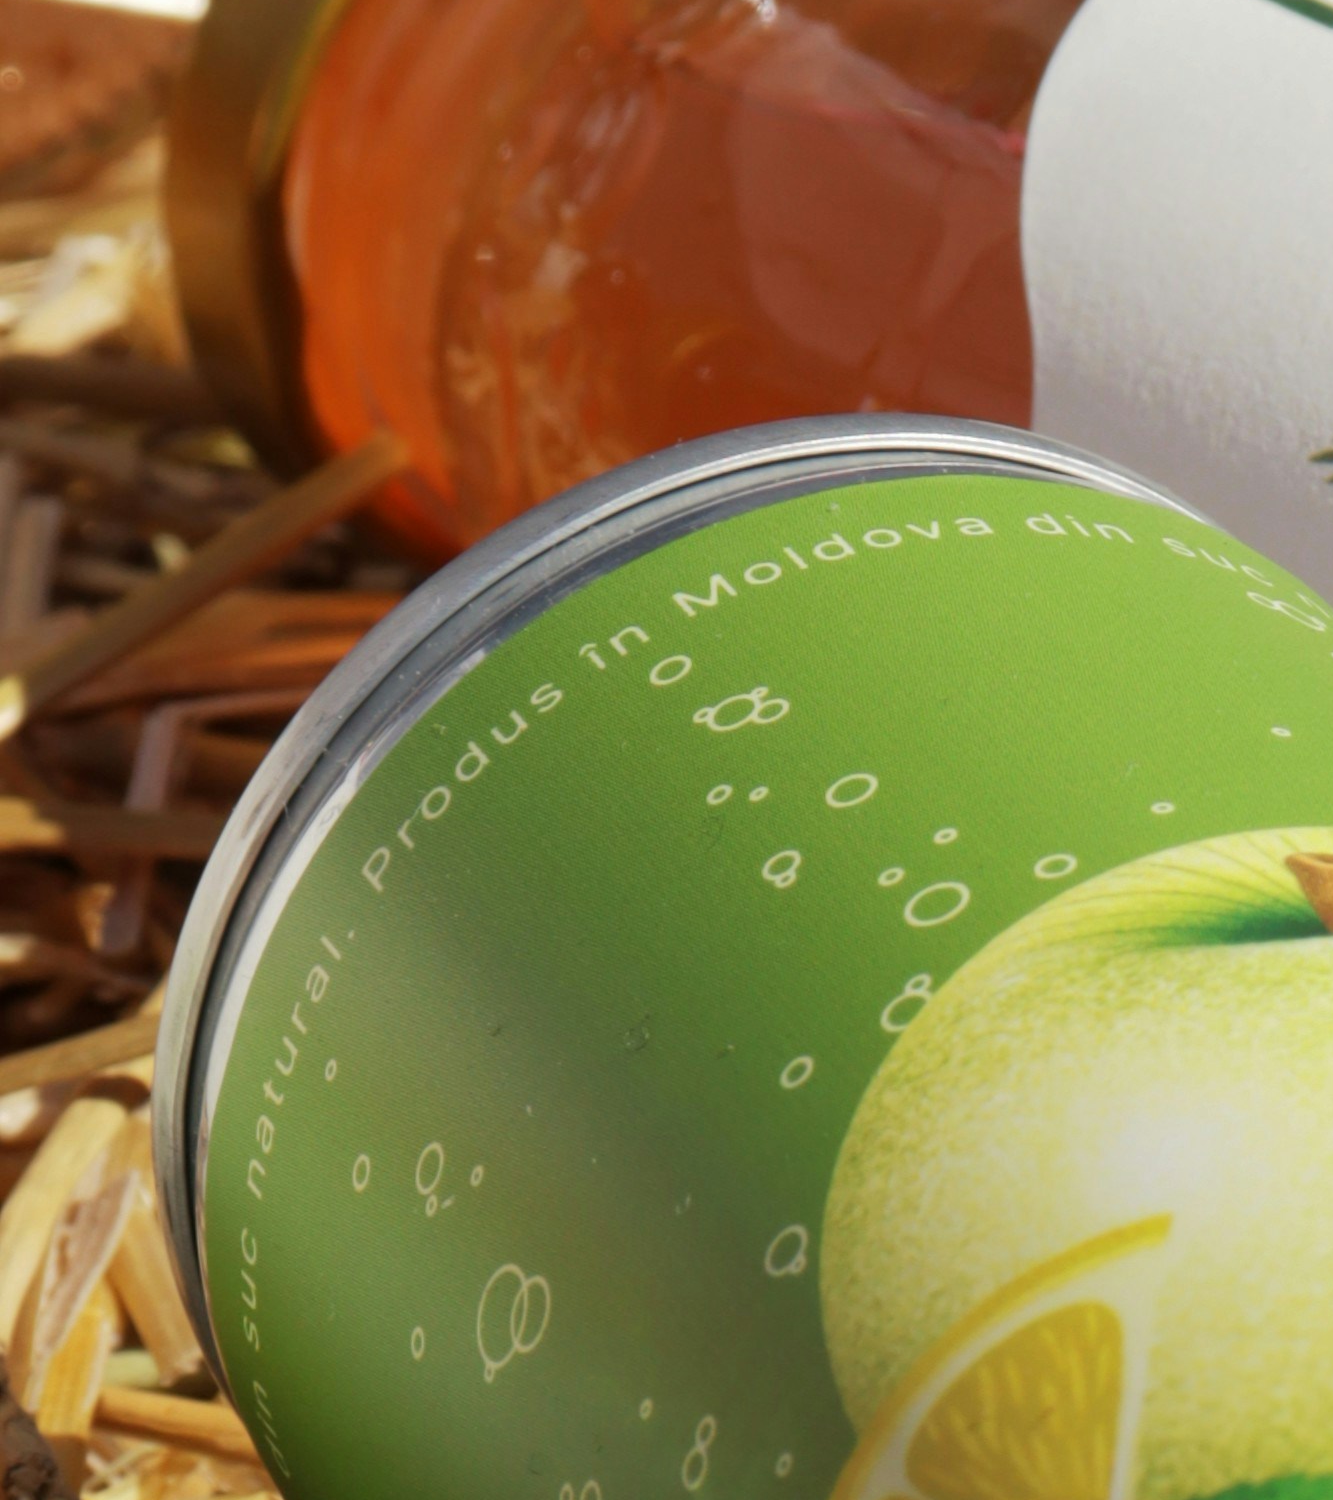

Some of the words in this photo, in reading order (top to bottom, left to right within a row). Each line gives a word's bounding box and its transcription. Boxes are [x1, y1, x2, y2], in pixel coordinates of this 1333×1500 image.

[670, 512, 995, 617] Moldova
[1023, 512, 1136, 544] din
[1161, 537, 1275, 587] suc
[577, 624, 650, 671] în
[361, 681, 564, 893] Produs
[247, 929, 357, 1200] natural.
[240, 1226, 261, 1353] suc
